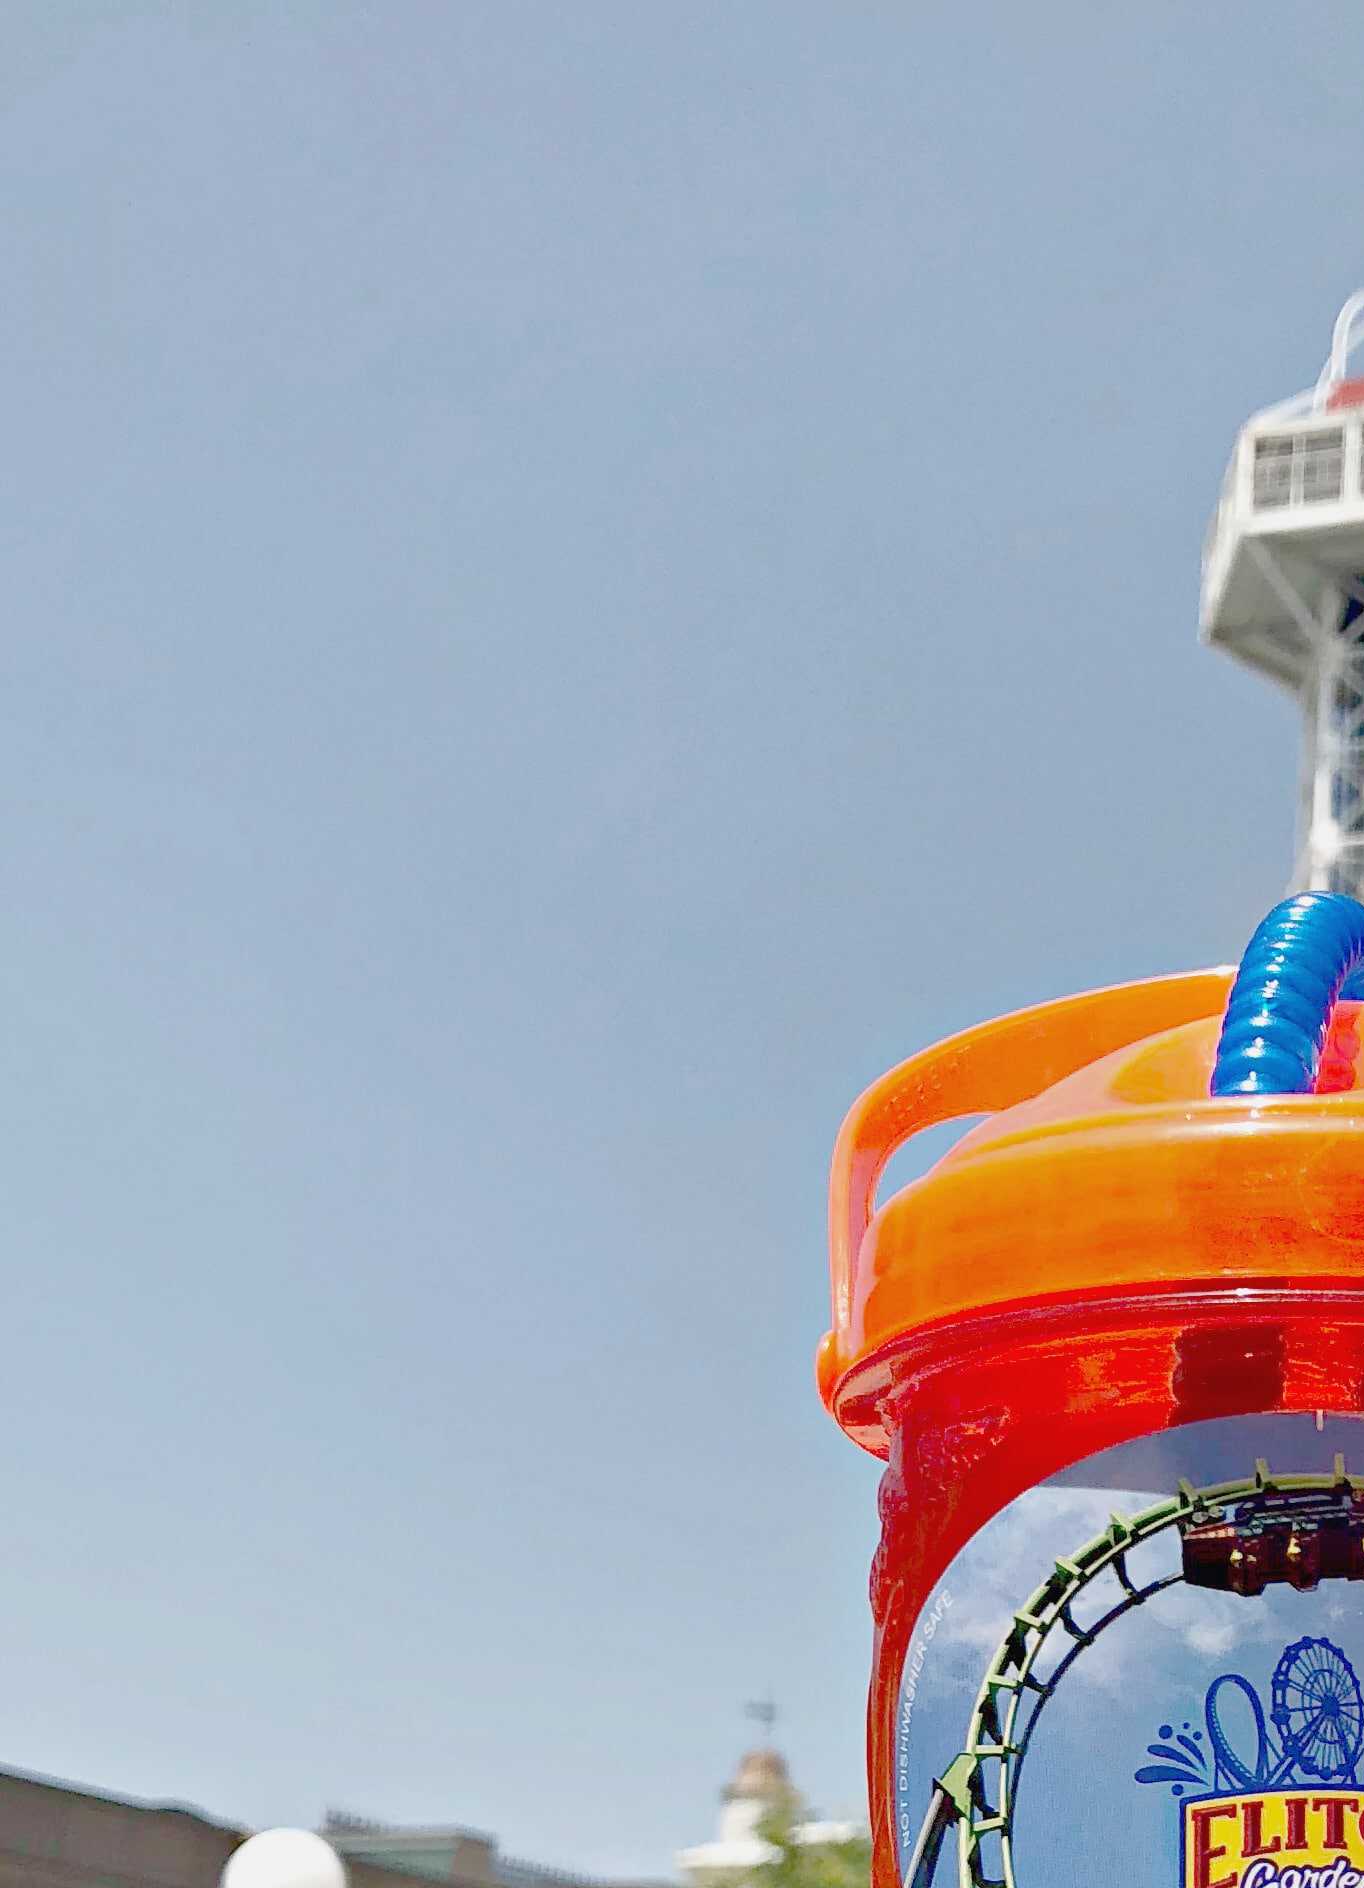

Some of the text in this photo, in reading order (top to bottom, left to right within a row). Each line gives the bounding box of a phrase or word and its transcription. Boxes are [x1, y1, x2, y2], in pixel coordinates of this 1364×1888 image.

[899, 1588, 953, 1848] NOT DISHWASHER SAFE
